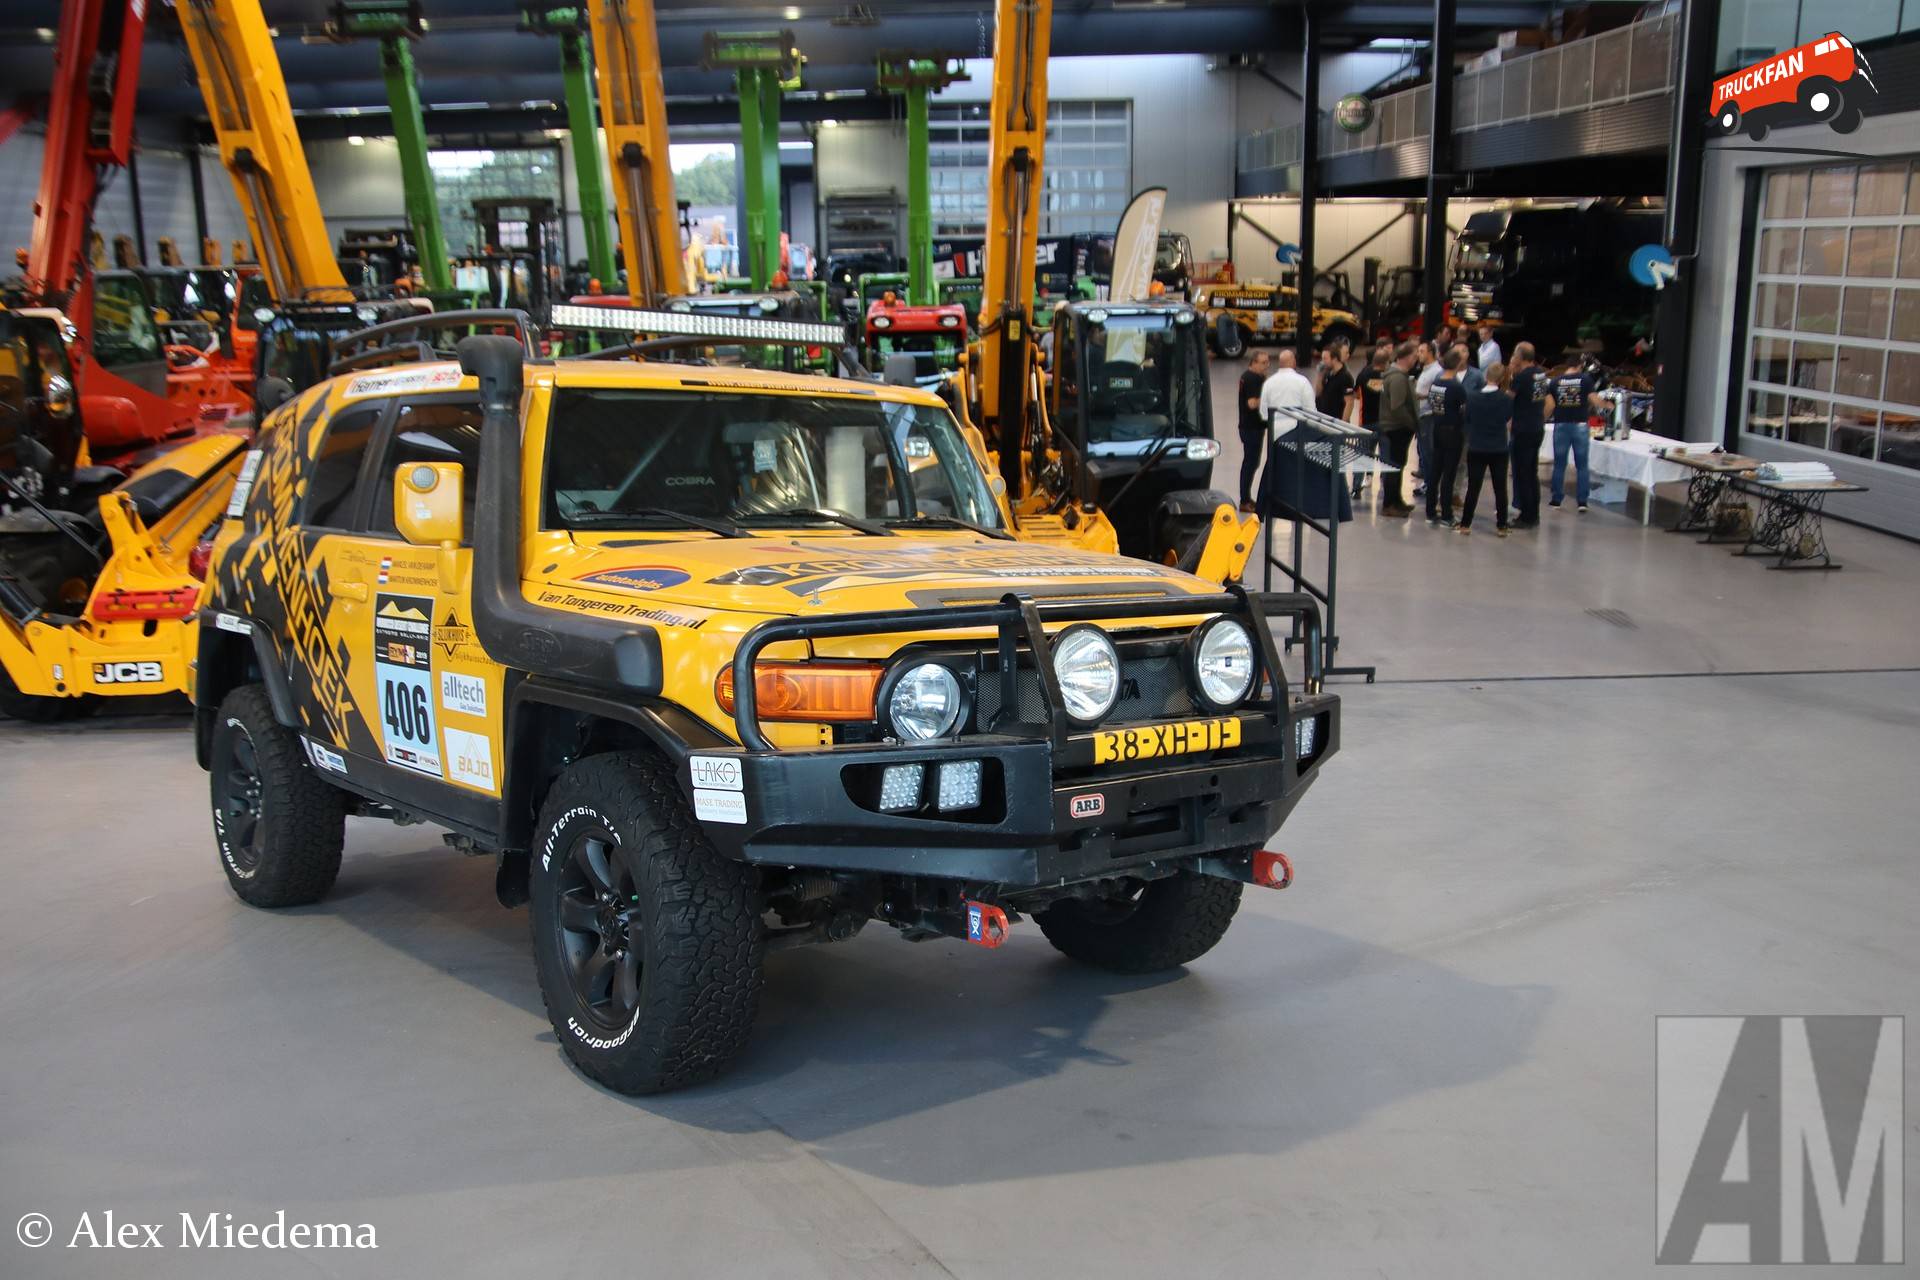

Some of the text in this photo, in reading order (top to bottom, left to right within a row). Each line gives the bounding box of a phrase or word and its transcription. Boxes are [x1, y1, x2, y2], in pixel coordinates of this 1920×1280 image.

[665, 476, 715, 486] COBRA
[537, 591, 708, 630] Van Tongeren Trading.nl
[93, 661, 164, 683] JCB
[444, 675, 485, 704] alltech
[385, 679, 431, 745] 406
[696, 760, 736, 783] LAKO
[1075, 798, 1101, 813] ARB
[541, 805, 598, 873] All-Terrain
